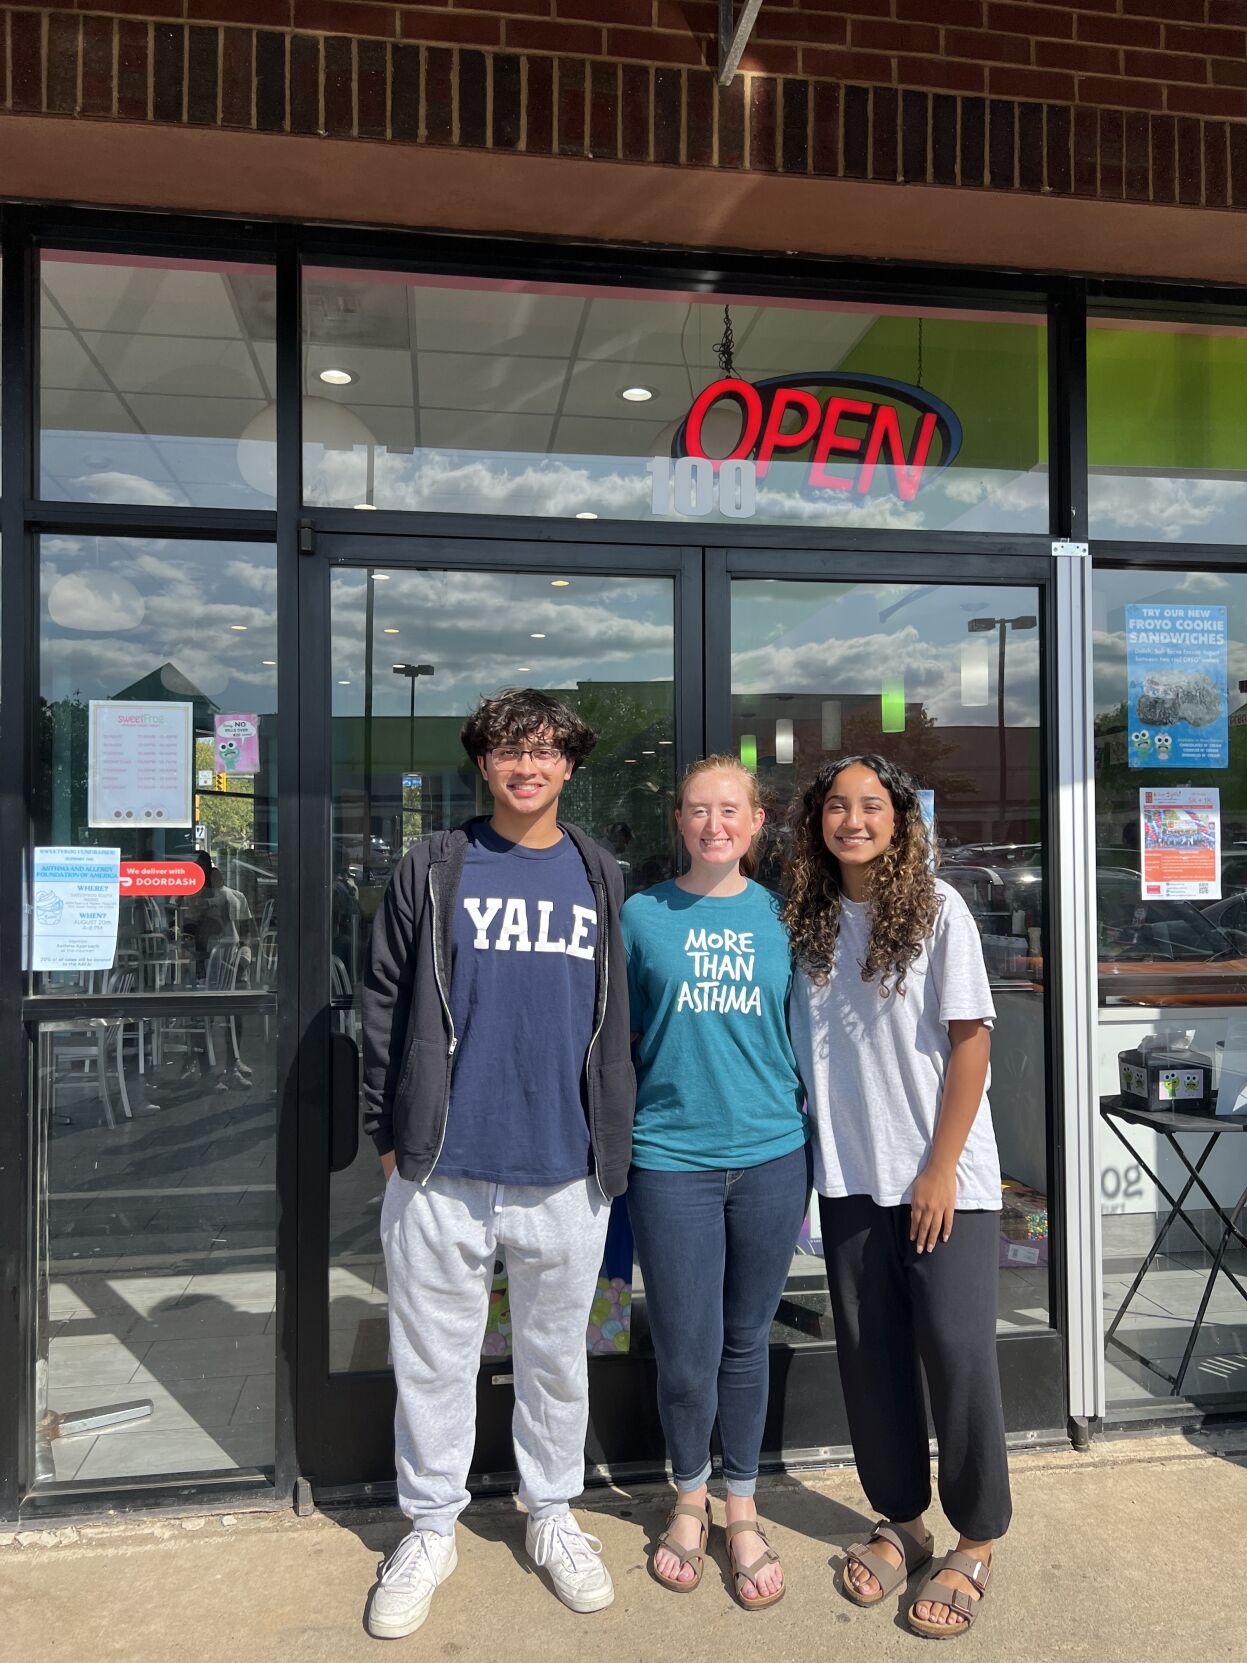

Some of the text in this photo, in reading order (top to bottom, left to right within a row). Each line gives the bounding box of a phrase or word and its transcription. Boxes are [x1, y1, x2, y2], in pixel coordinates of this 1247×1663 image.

[685, 378, 937, 501] OPEN
[646, 455, 756, 518] 100
[1129, 619, 1224, 631] FROYO COOKIE
[1142, 609, 1211, 618] TRY OUR NEW
[1129, 632, 1225, 645] SANDWICHES
[136, 878, 196, 886] DOORDASH
[464, 897, 597, 960] YALE
[684, 928, 755, 955] MORE
[686, 951, 755, 982] THAN
[677, 980, 761, 1017] ASTHMA
